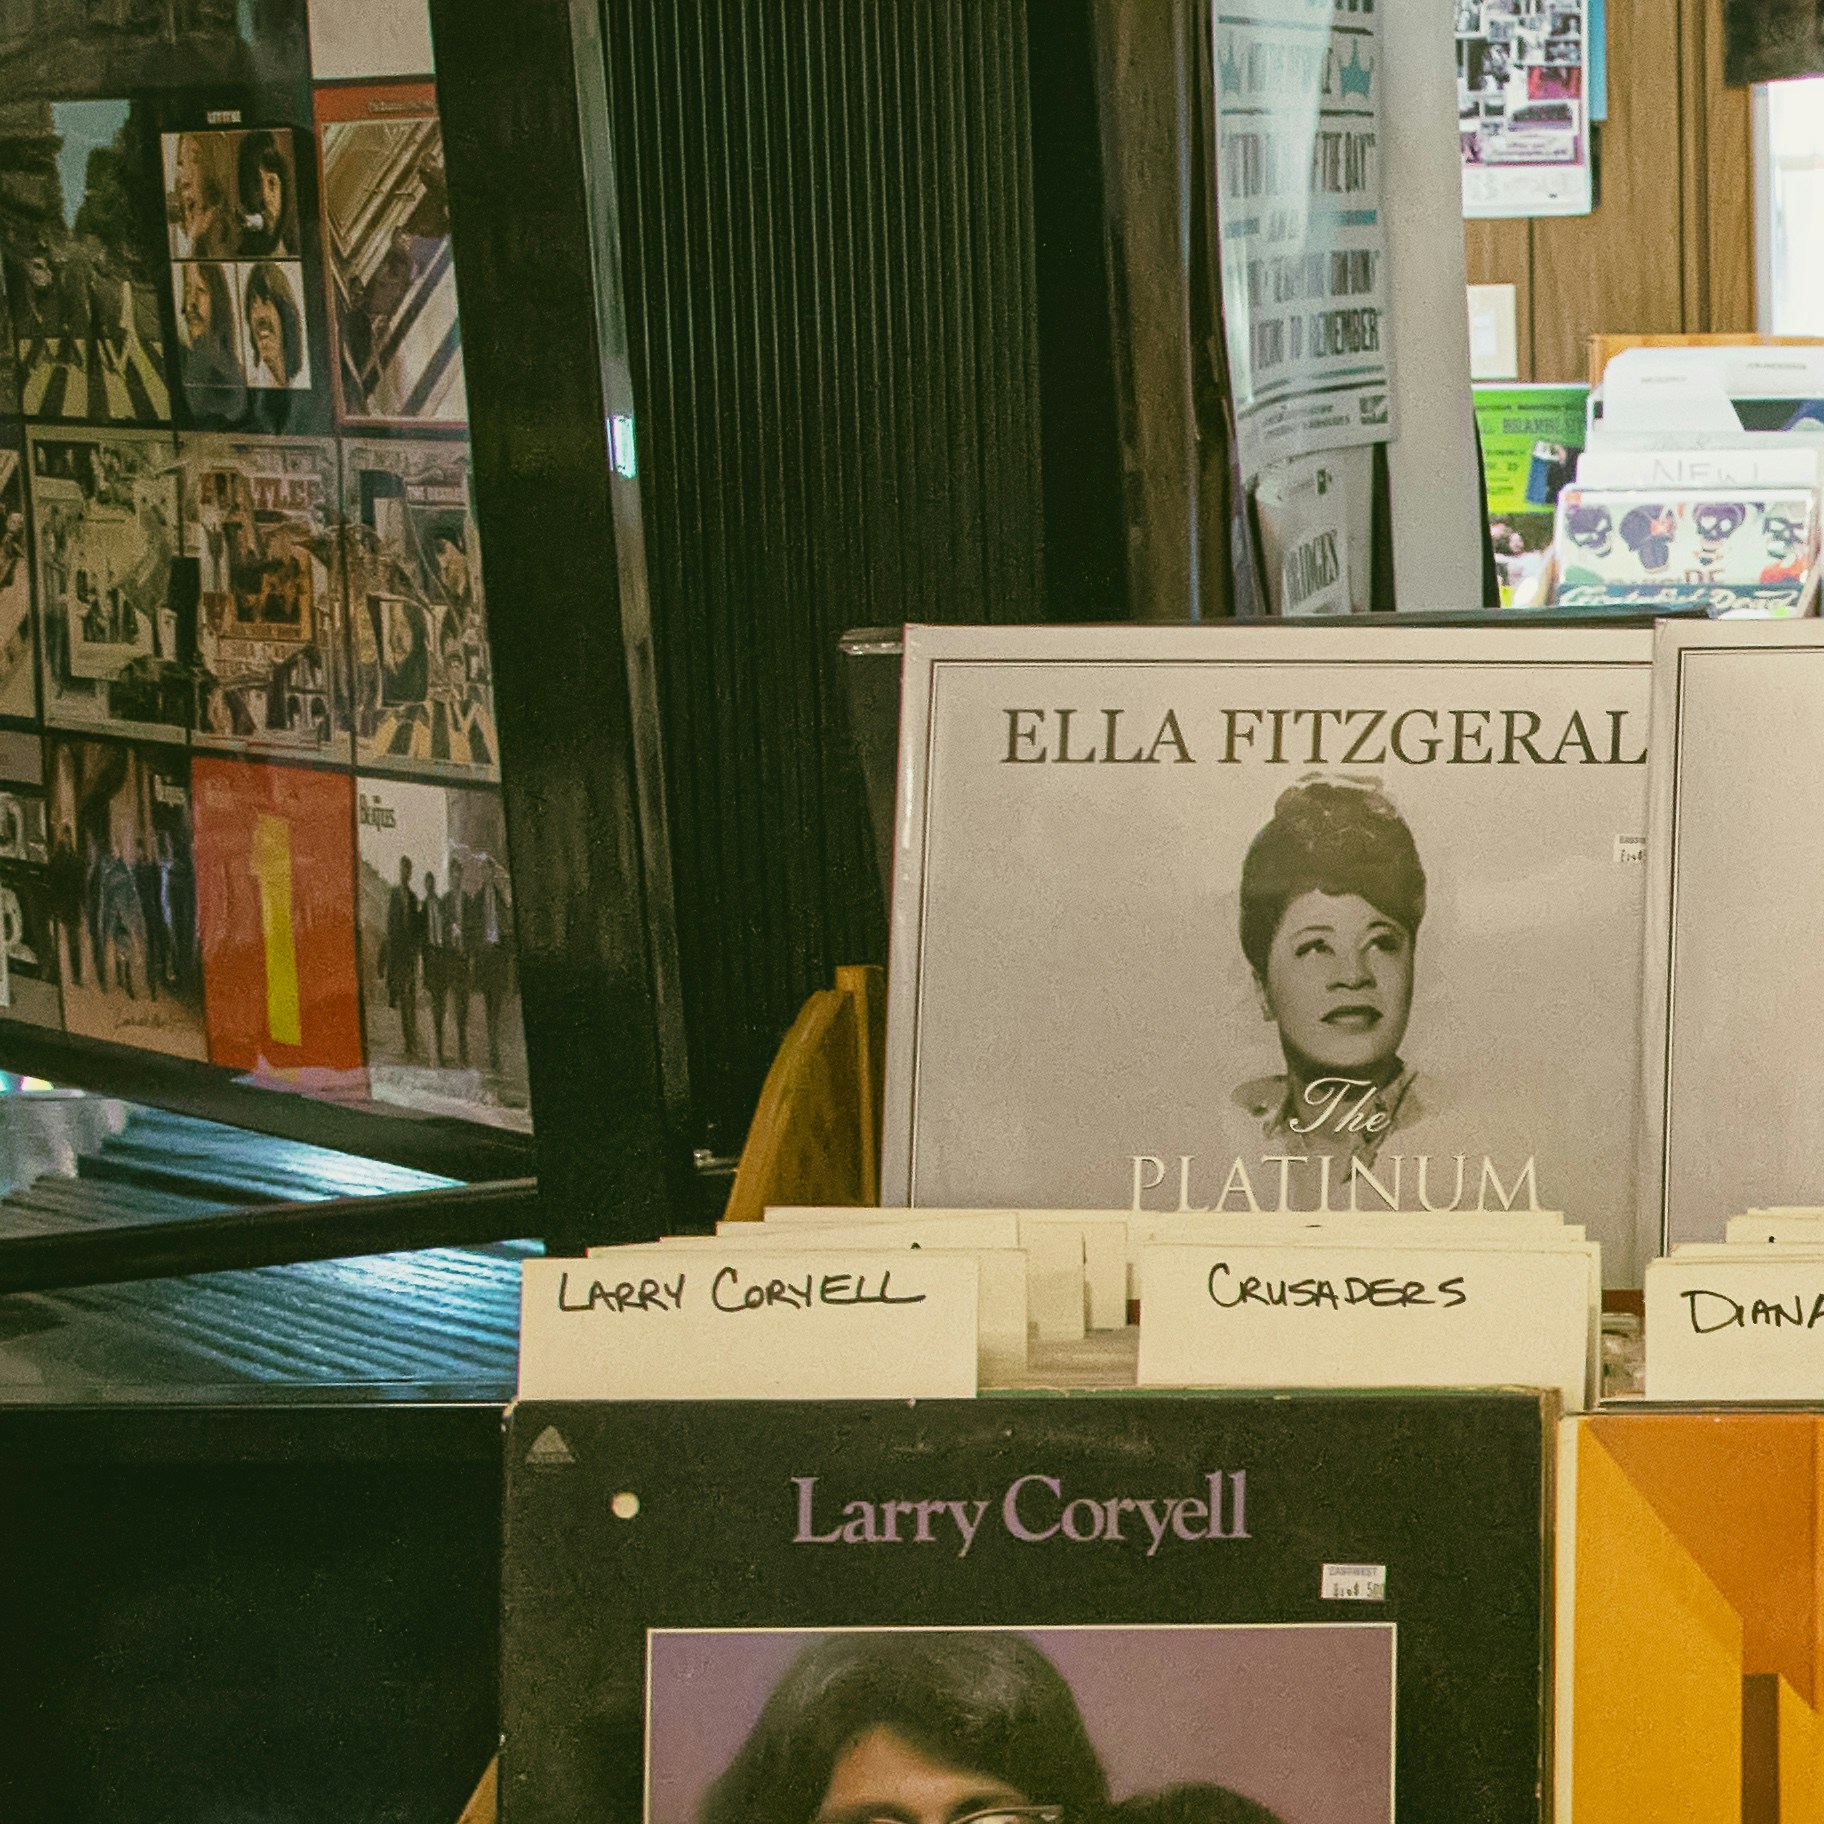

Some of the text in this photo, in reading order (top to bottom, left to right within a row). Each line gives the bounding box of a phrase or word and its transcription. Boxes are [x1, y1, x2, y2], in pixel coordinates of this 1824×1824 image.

[1000, 707, 1197, 766] ELLA
[1288, 1077, 1392, 1135] The
[1128, 1155, 1543, 1213] PLATINUM
[556, 1265, 930, 1314] LARRY CORYELL
[1206, 1262, 1469, 1313] CRUSADERS
[790, 1469, 1252, 1559] Larry Coryell
